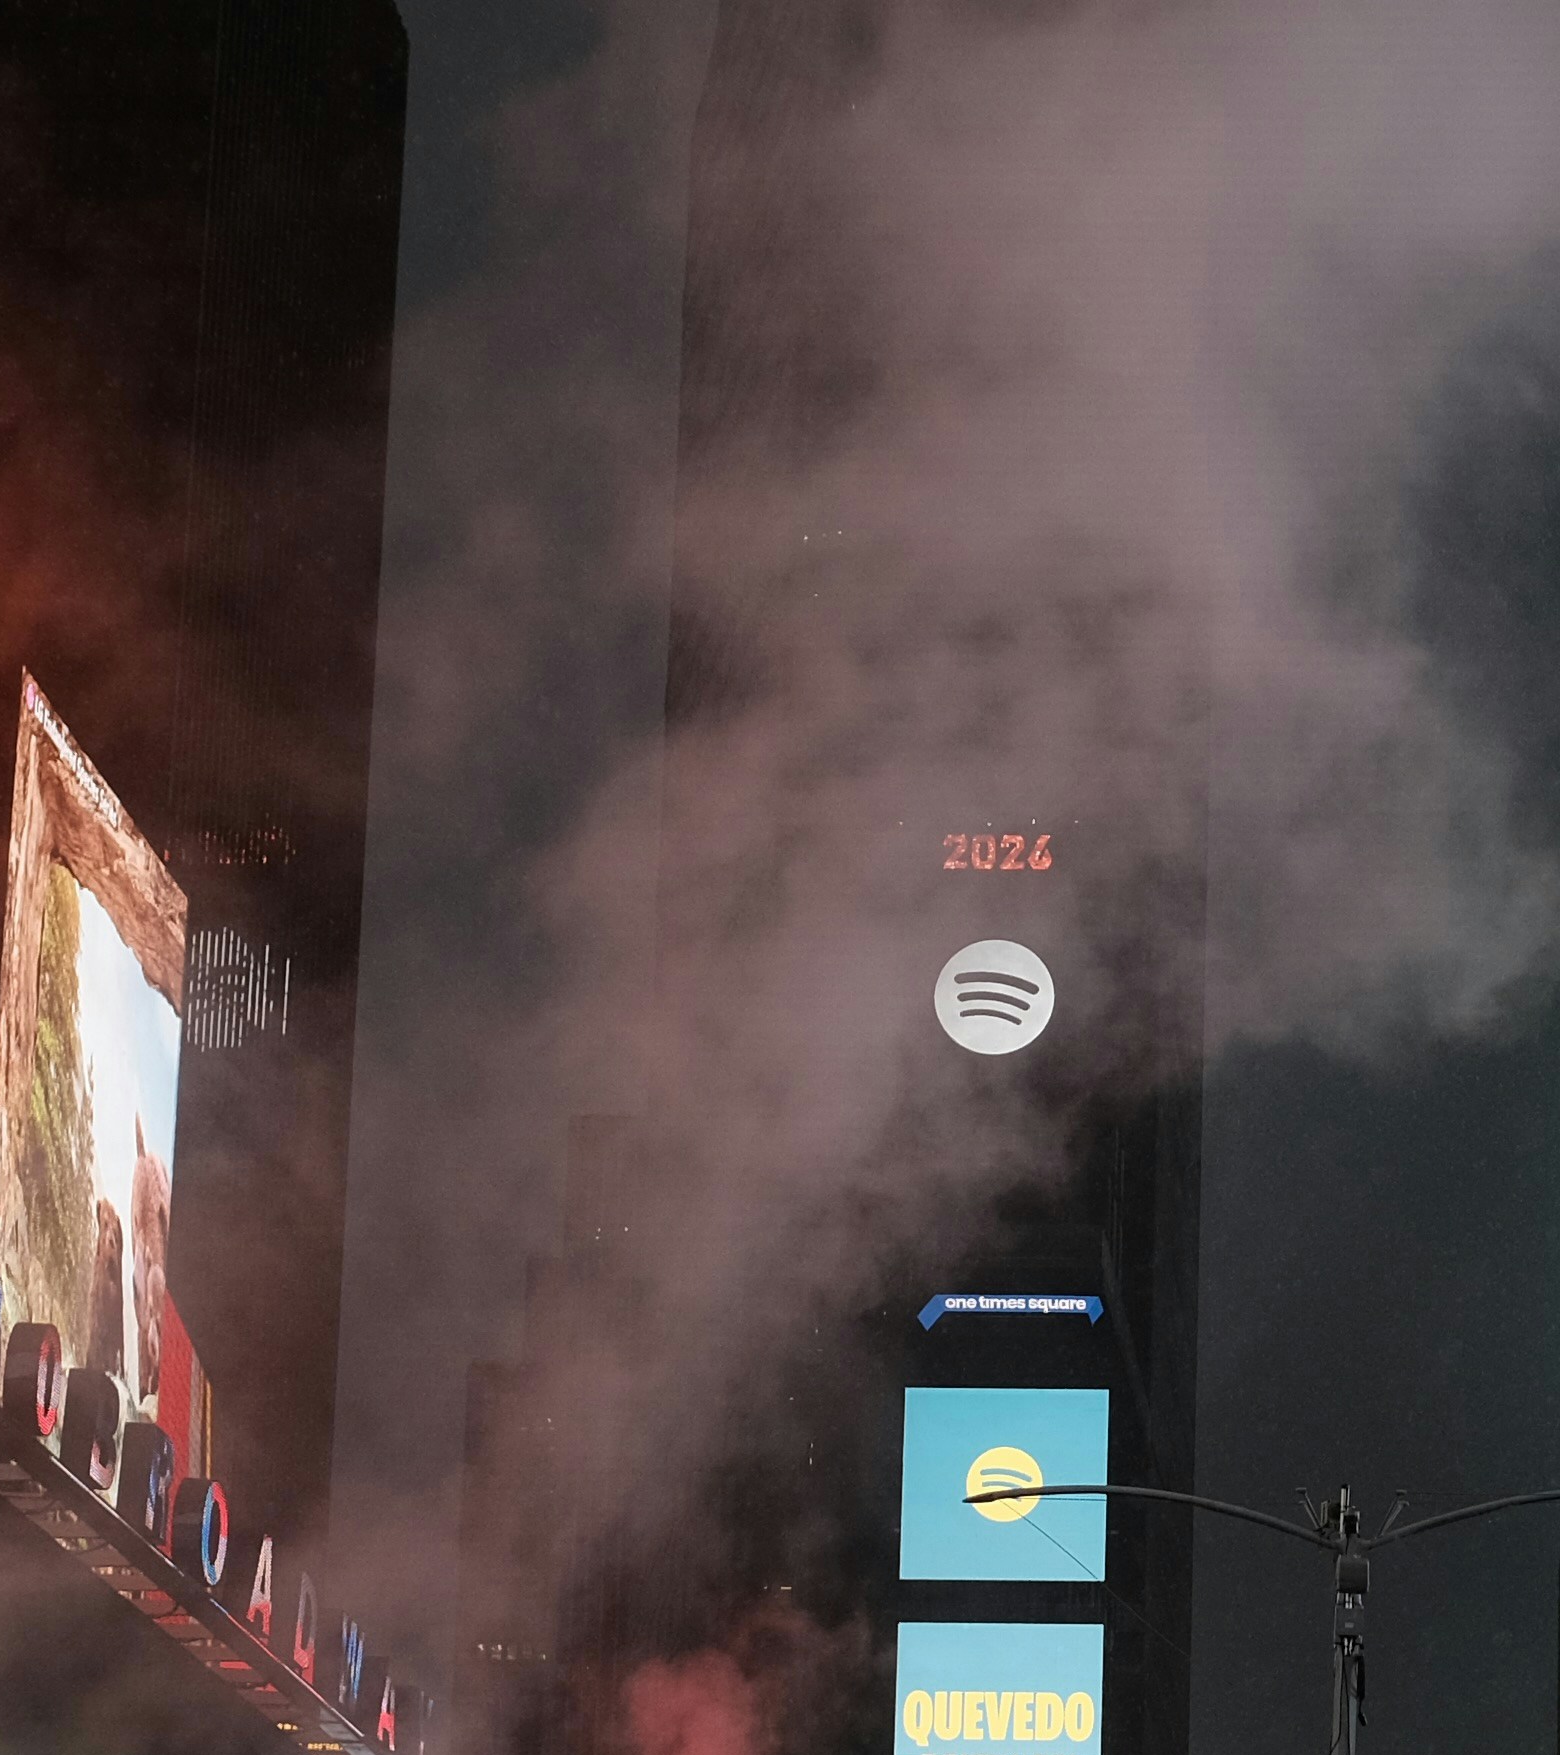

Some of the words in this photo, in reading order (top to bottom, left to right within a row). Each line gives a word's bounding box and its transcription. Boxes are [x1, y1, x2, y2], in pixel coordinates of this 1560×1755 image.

[942, 834, 1053, 871] 2026
[944, 1295, 976, 1311] one
[977, 1294, 1026, 1311] times
[1028, 1295, 1087, 1315] square
[903, 1690, 1094, 1747] QUEVEDO
